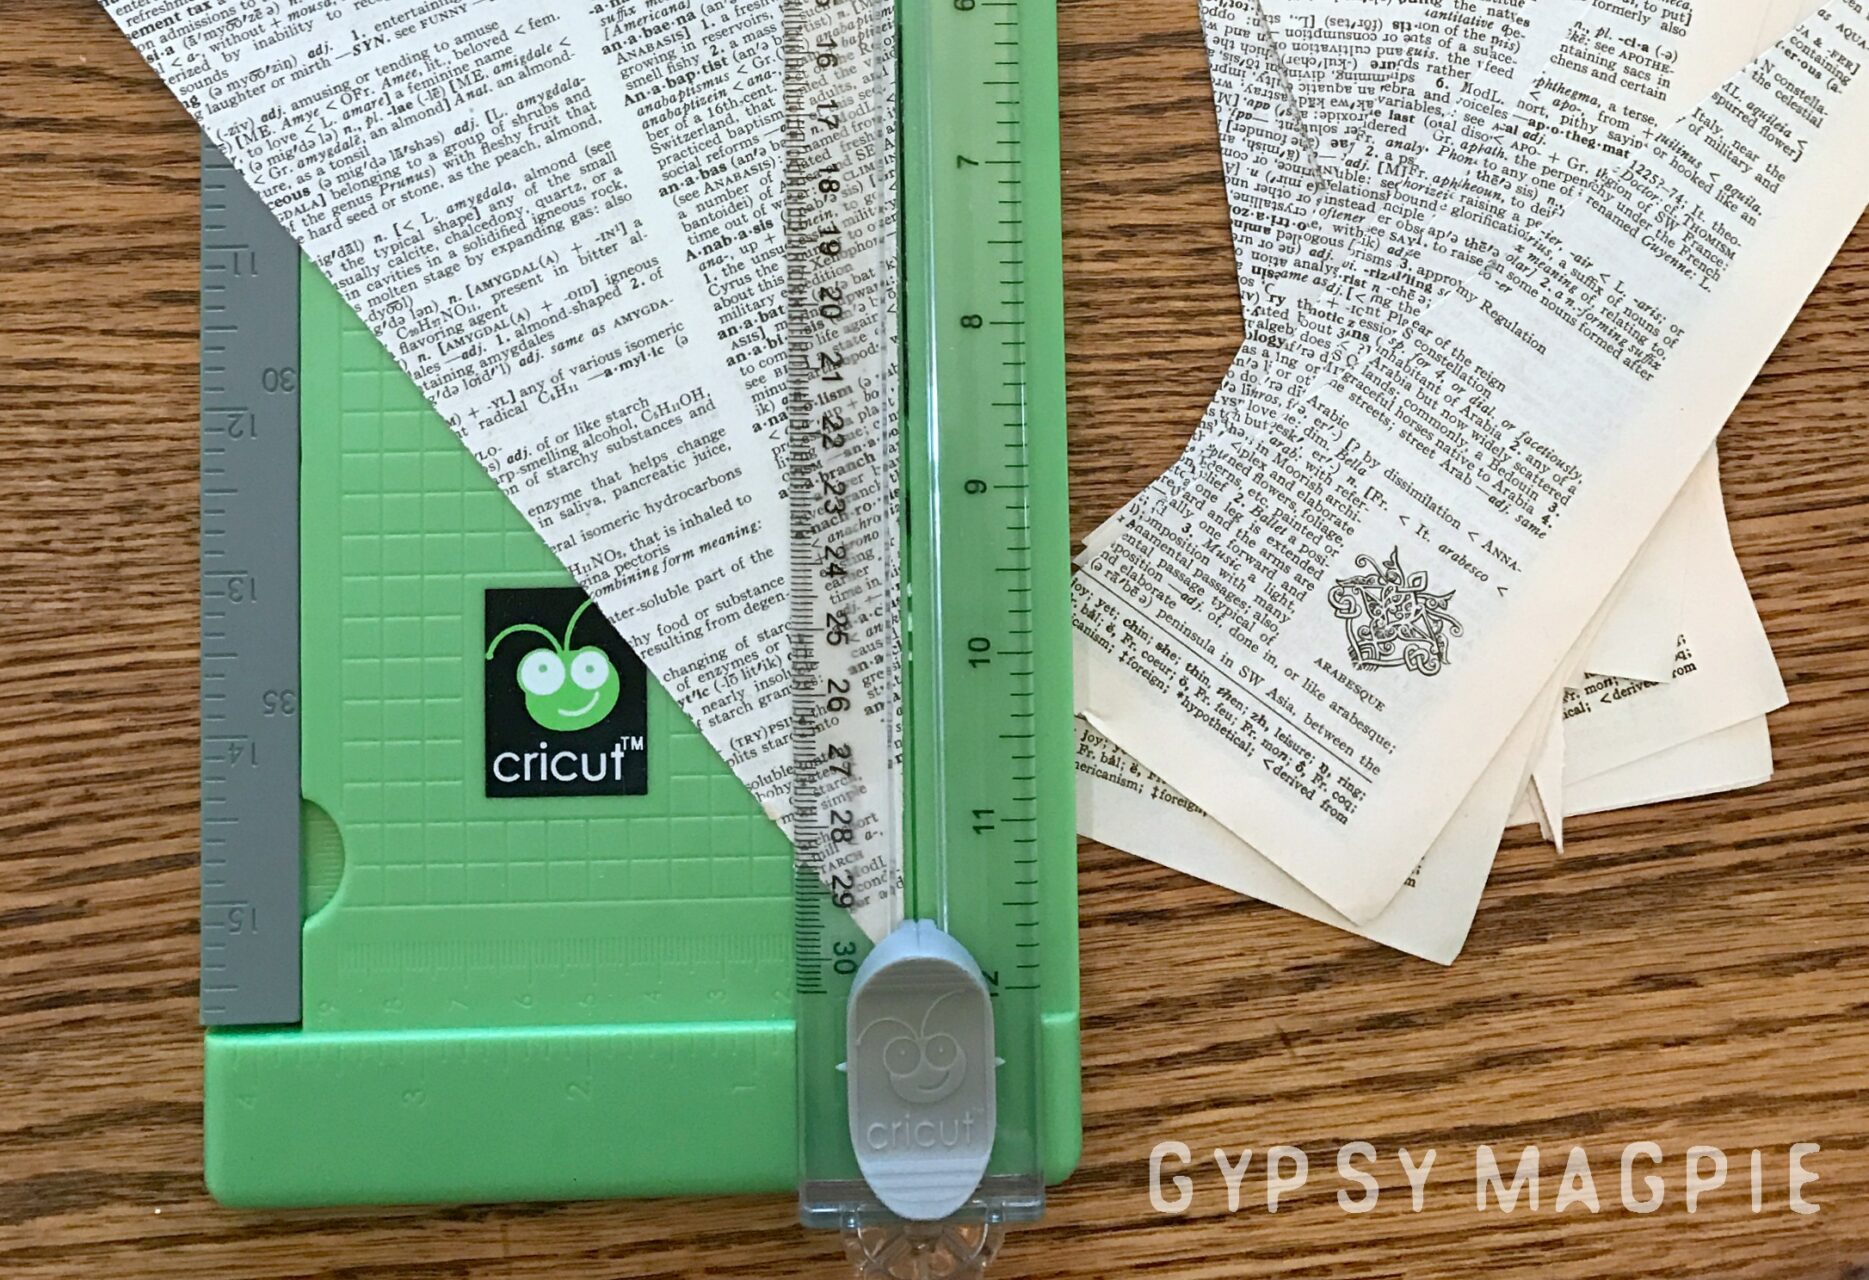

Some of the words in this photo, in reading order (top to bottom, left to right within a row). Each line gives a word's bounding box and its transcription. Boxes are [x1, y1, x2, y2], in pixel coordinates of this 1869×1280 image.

[815, 37, 838, 69] 16
[816, 99, 839, 130] 17
[957, 154, 979, 169] 7
[818, 163, 841, 195] 18
[818, 225, 842, 256] 19
[366, 280, 419, 308] molten
[819, 286, 842, 320] 20
[398, 321, 465, 355] flavoring
[624, 321, 685, 353] isomeric
[961, 314, 983, 329] 8
[820, 351, 844, 383] 21
[545, 449, 599, 479] starchy
[605, 414, 684, 454] substances
[821, 415, 845, 449] 22
[526, 487, 583, 518] enzyme
[642, 466, 743, 515] hydrocarbons
[823, 481, 846, 516] 23
[964, 479, 987, 495] 9
[613, 543, 671, 577] pectoris
[824, 544, 848, 579] 24
[826, 611, 849, 646] 25
[662, 647, 729, 683] changing
[968, 637, 991, 669] 10
[827, 678, 851, 713] 26
[493, 741, 625, 782] cricut
[828, 743, 852, 778] 27
[830, 809, 853, 844] 28
[973, 806, 996, 835] 11
[831, 874, 855, 910] 29
[832, 941, 857, 976] 30
[866, 1111, 974, 1150] cricut
